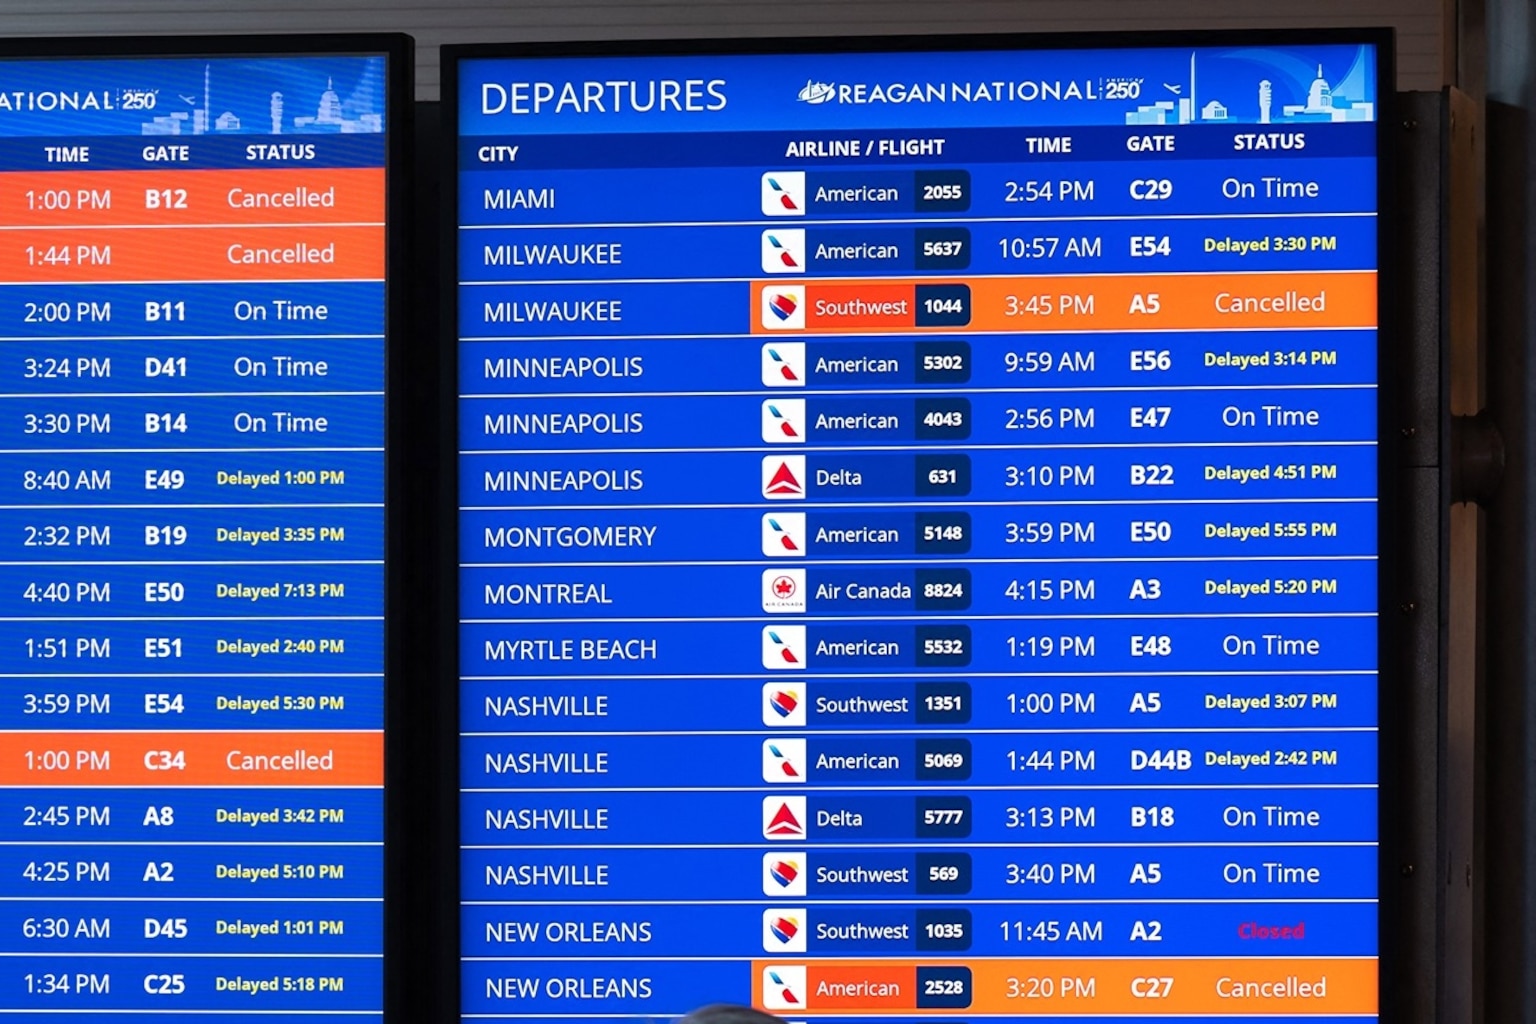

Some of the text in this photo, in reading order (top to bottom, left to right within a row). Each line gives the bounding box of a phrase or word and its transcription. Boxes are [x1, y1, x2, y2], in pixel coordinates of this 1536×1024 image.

[122, 92, 156, 110] 250
[482, 79, 727, 115] DEPARTURES
[838, 80, 1097, 104] REAGAN NATIONAL
[1105, 81, 1141, 100] 250
[44, 146, 89, 163] TIME
[142, 145, 189, 161] GATE
[245, 144, 316, 161] STATUS
[478, 145, 519, 162] CITY
[785, 140, 861, 158] AIRLINE
[878, 138, 946, 156] FLIGHT
[1025, 136, 1072, 154] TIME
[1126, 135, 1175, 152] GATE
[1234, 133, 1305, 151] STATUS
[25, 189, 71, 210] 1:00
[77, 189, 111, 210] PM
[145, 188, 188, 209] B12
[227, 186, 335, 209] Cancelled
[23, 525, 70, 546] 2:32
[76, 525, 111, 546] PM
[145, 525, 188, 546] B19
[216, 526, 280, 546] Delayed
[283, 527, 316, 542] 3:35
[319, 527, 345, 542] PM
[485, 578, 1337, 605] MONTREAL Air Canada 8824 4:15 PM A3 Delayed 5:20 PM
[23, 693, 70, 714] 3:59
[76, 693, 110, 714] PM
[144, 693, 185, 714] E54
[216, 695, 280, 715] Delayed
[283, 695, 316, 710] 5:30
[319, 695, 345, 710] PM
[485, 749, 1337, 774] NASHVILLE American 5069 1:44 PM D44B Delayed 2:42 PM
[486, 920, 1305, 942] NEW ORLEANS Southwest 1035 11:45 AM A2 Closed
